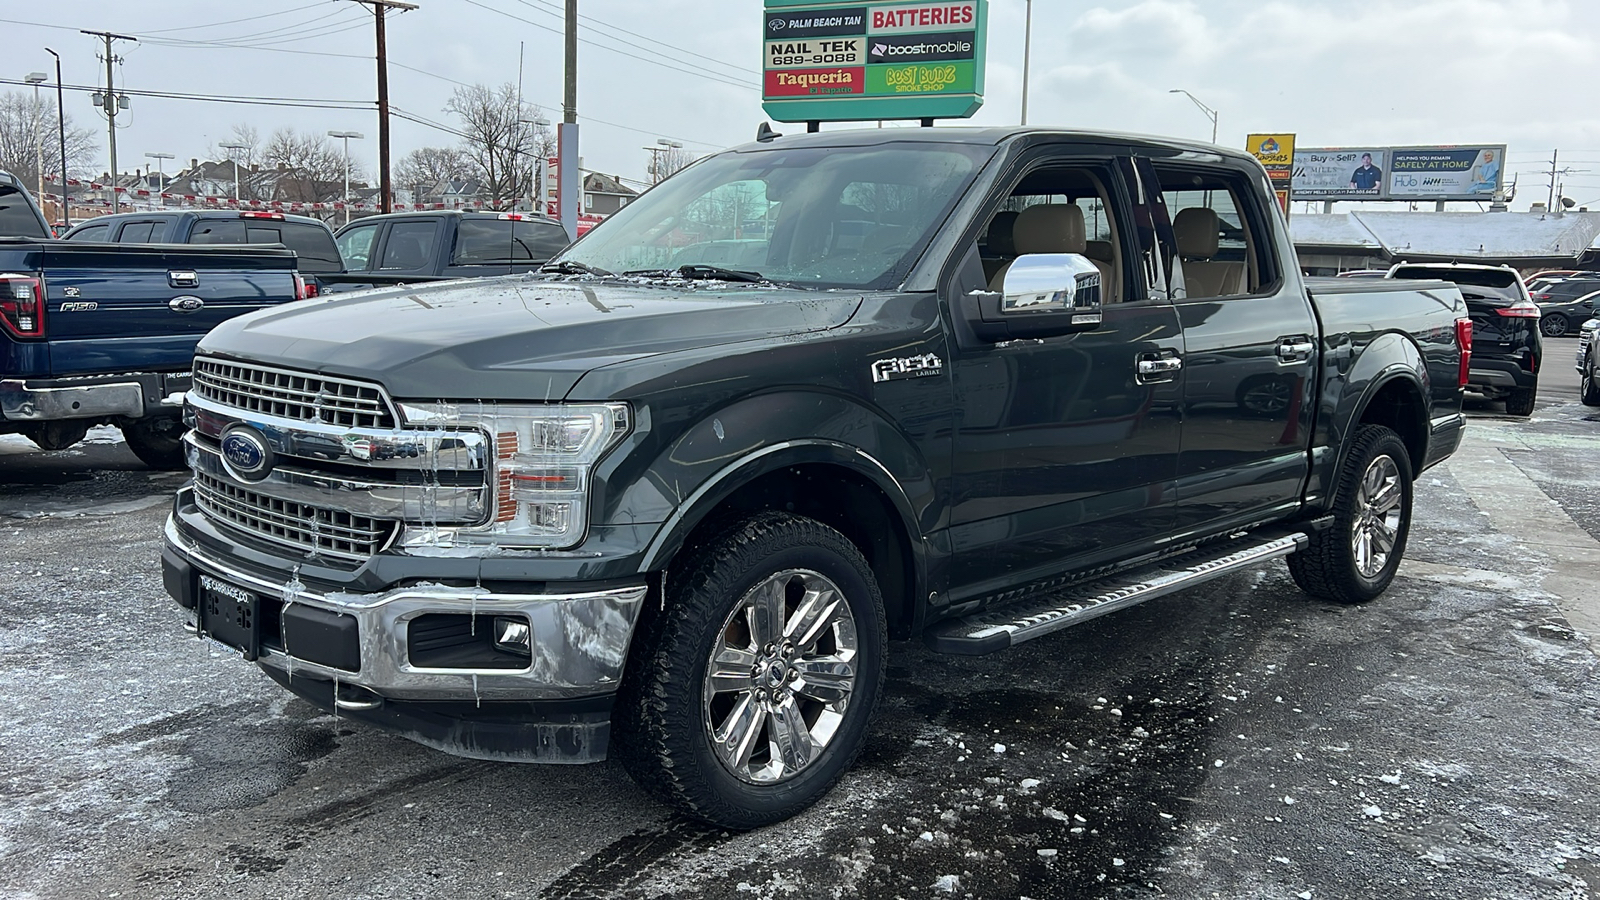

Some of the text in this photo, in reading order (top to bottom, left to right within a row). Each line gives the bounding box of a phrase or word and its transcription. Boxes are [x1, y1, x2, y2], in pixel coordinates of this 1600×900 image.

[788, 15, 861, 29] PALM BEACH TAN
[873, 5, 973, 29] BATTERIES
[771, 40, 857, 55] NAIL TEK
[772, 53, 856, 66] 689-9088
[777, 69, 852, 88] Taquería
[895, 83, 945, 92] SMOKE SHOP
[1310, 154, 1328, 164] Buy
[1336, 153, 1357, 162] Sell?
[1394, 161, 1427, 169] SAFELY
[1442, 160, 1469, 168] HOME
[1394, 174, 1418, 187] Hub
[916, 369, 940, 377] LARIAT
[227, 438, 252, 464] Ford
